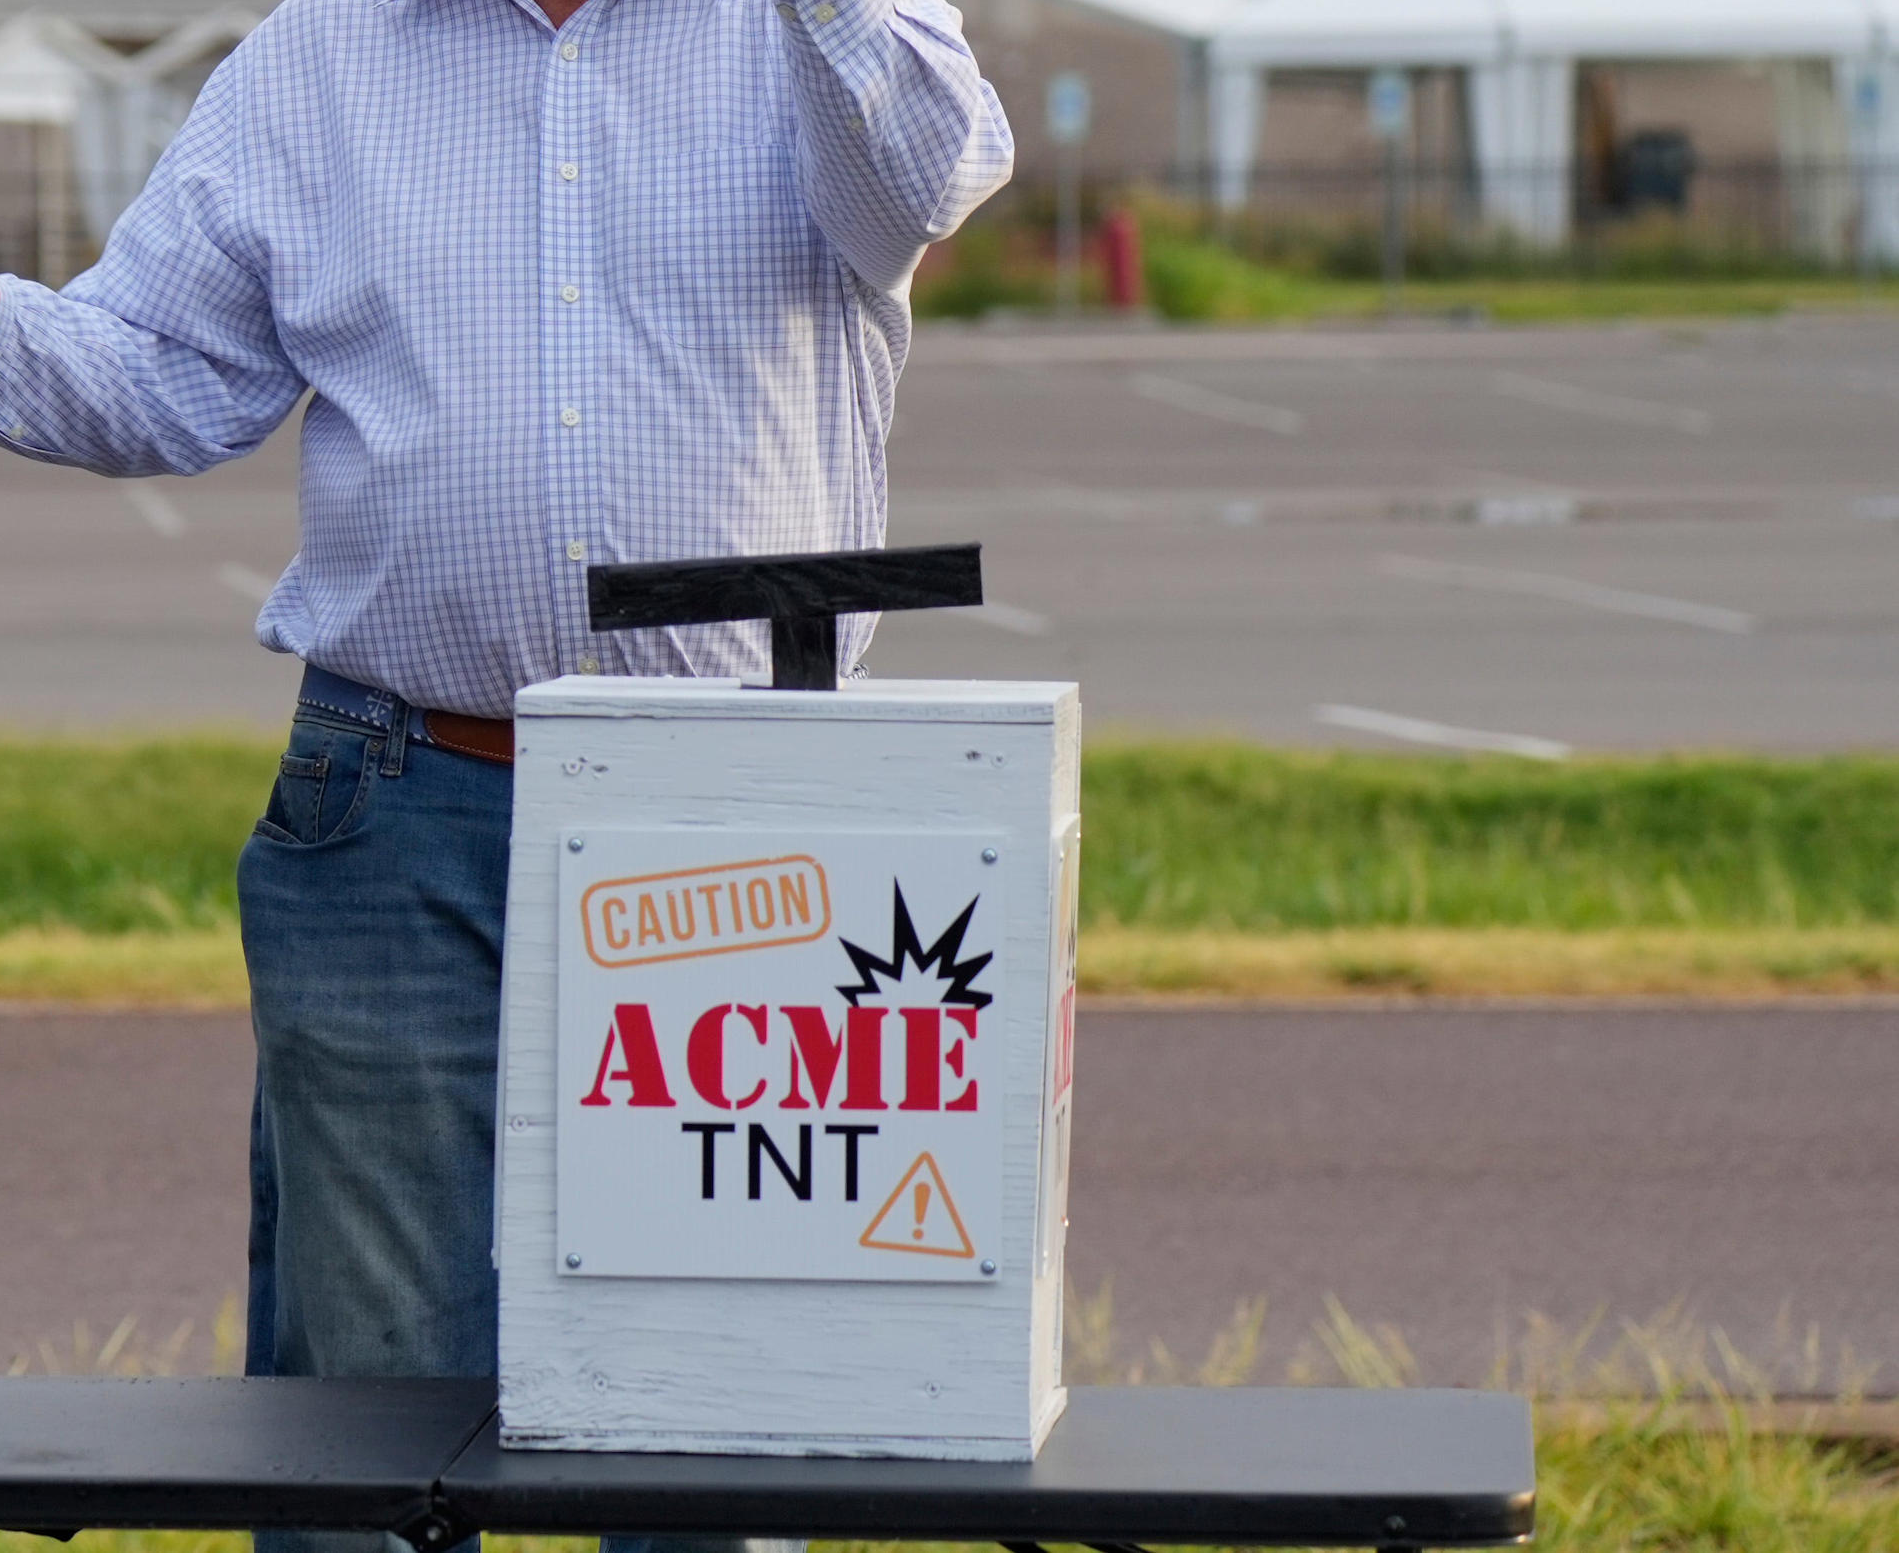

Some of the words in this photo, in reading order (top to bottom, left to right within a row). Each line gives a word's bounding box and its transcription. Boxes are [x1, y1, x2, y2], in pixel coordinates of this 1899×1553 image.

[602, 871, 811, 952] CAUTION
[579, 1003, 979, 1113] ACME
[681, 1122, 880, 1202] TNT
